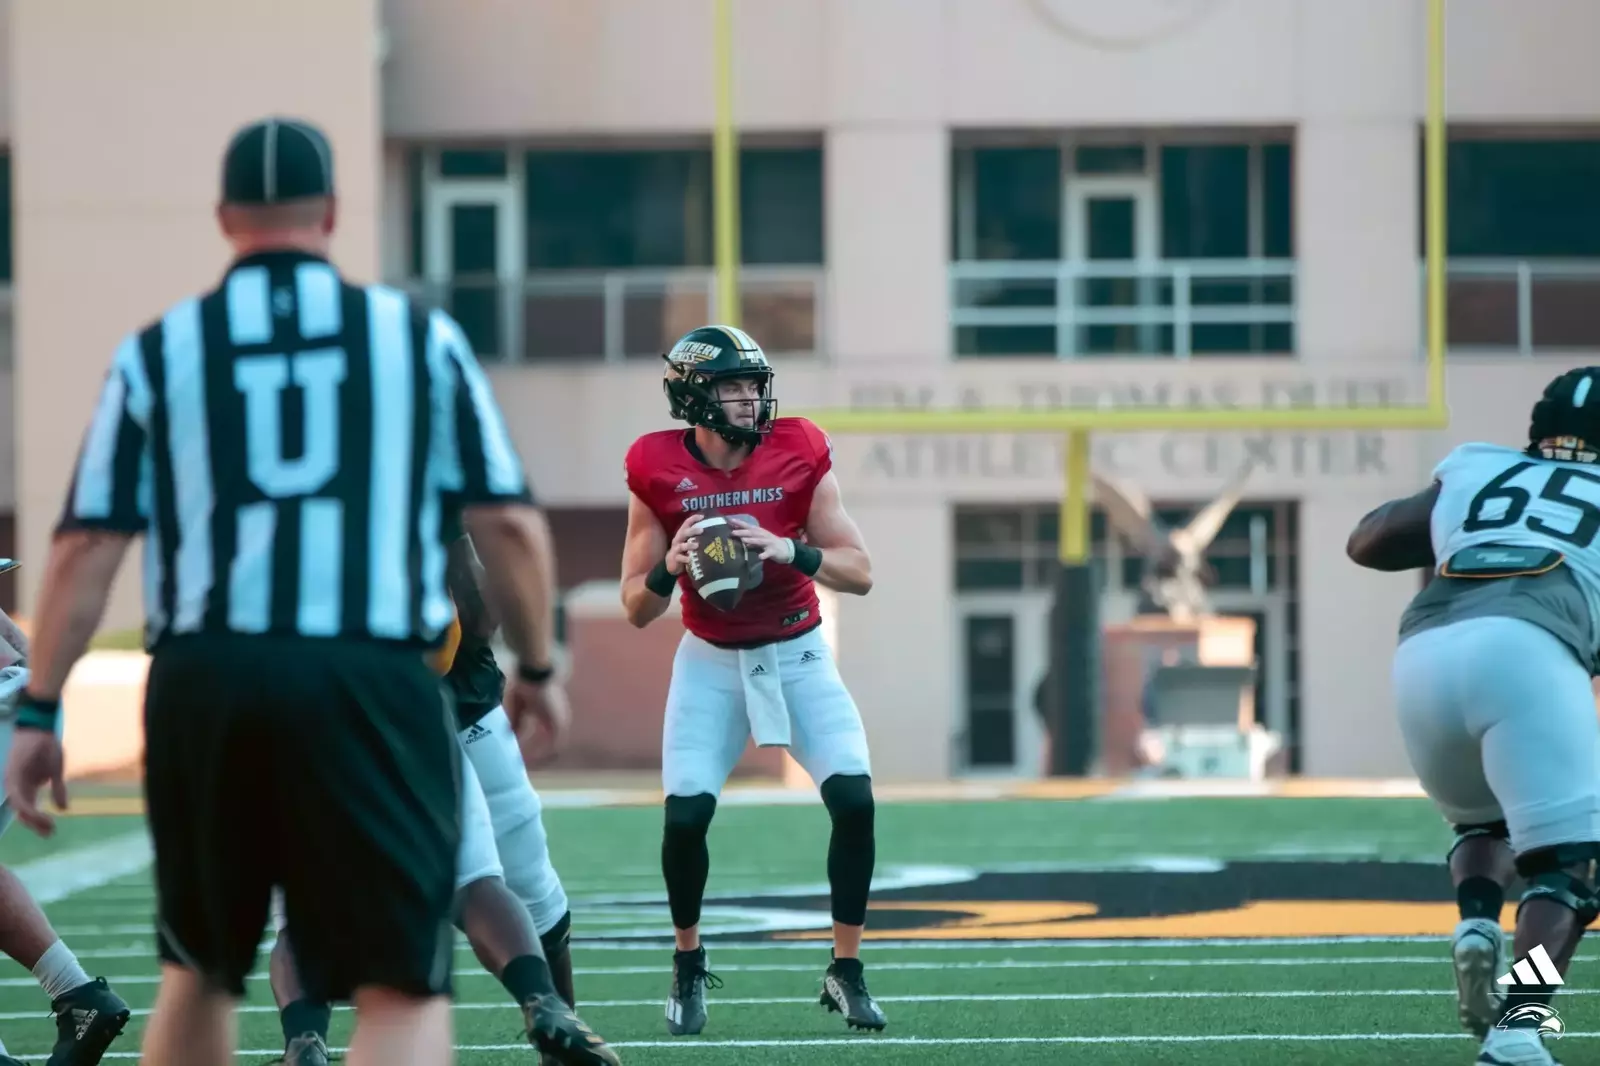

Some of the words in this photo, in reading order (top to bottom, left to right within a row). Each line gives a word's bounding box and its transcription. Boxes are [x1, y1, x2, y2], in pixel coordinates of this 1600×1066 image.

[233, 346, 347, 498] U
[859, 434, 1139, 480] ATHLEC
[681, 490, 750, 512] SOUTHERN
[752, 486, 785, 504] MISS
[1463, 461, 1600, 548] 65
